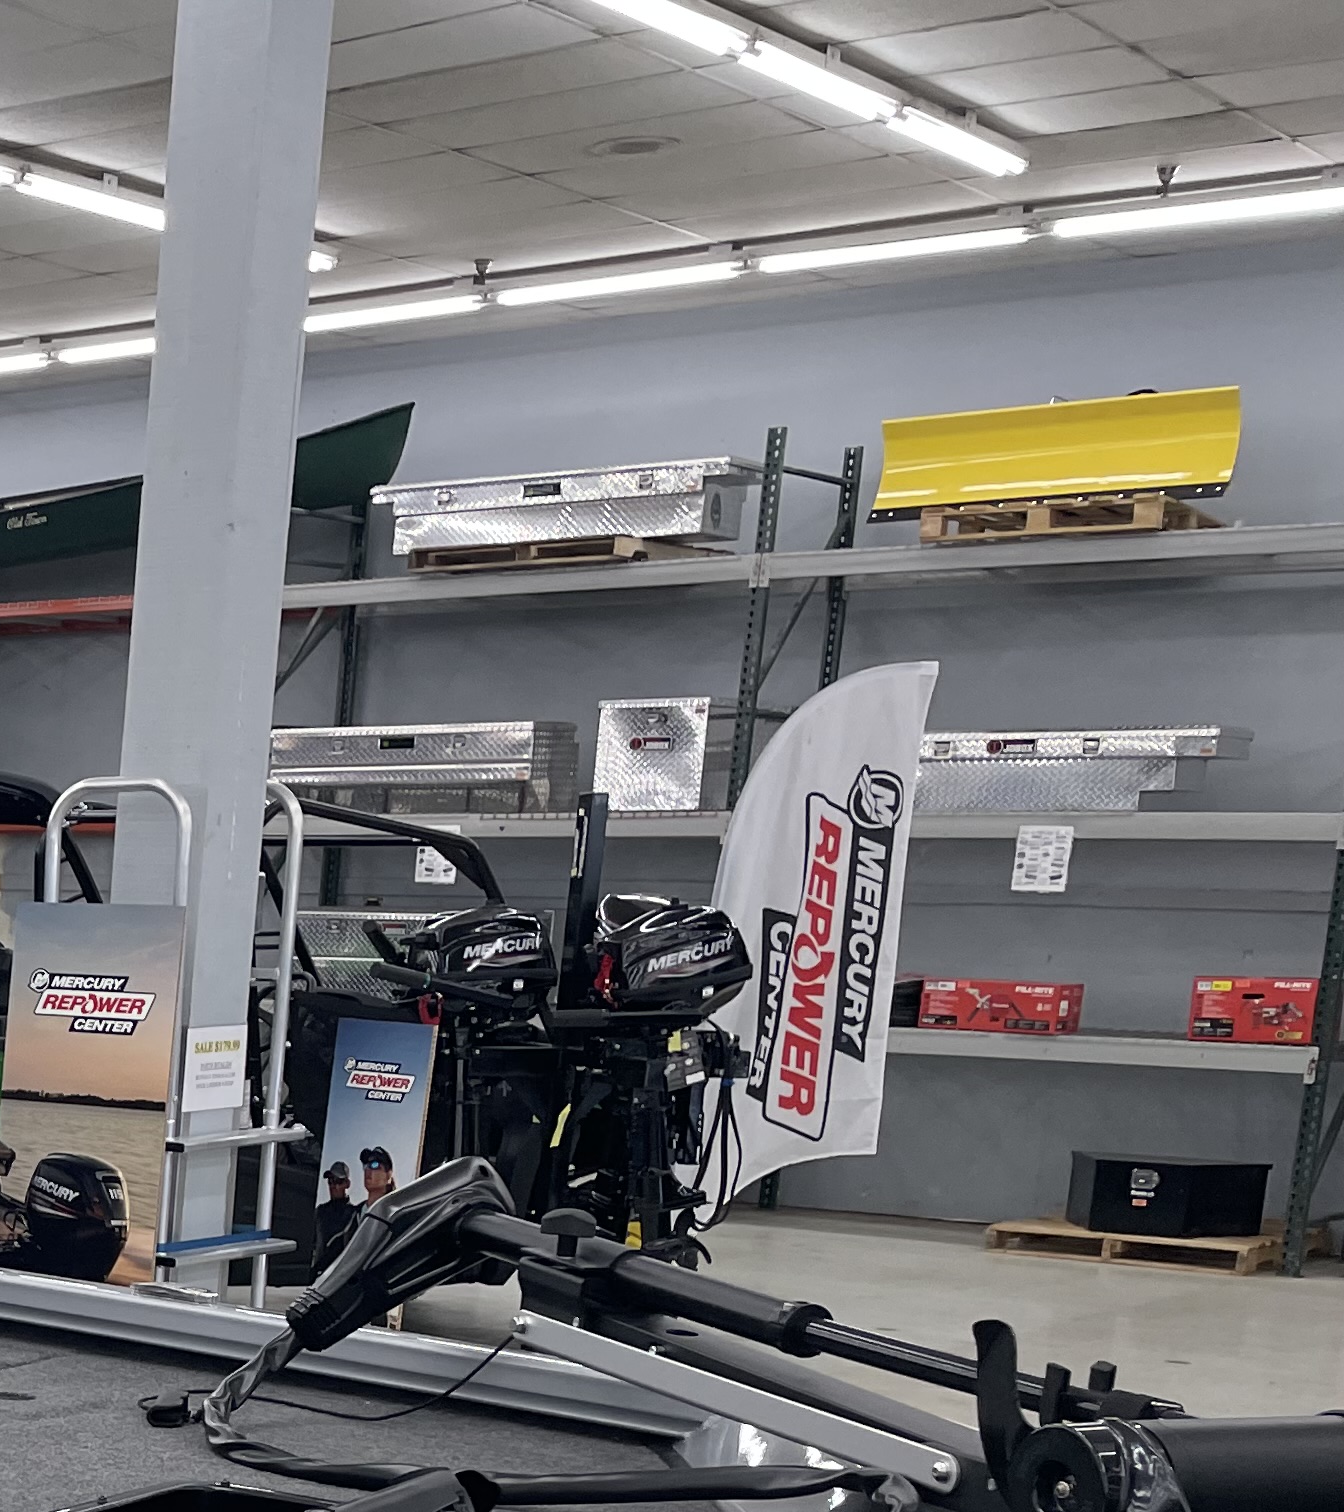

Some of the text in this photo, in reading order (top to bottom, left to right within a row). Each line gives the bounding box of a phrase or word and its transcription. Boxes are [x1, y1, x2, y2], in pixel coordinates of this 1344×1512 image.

[463, 937, 543, 960] MERCURY
[648, 936, 734, 973] MERCURY
[840, 835, 886, 1054] MERCURY
[778, 815, 844, 1117] REPOWER
[50, 976, 126, 990] MERCURY
[42, 993, 146, 1015] REPOWER
[749, 920, 793, 1089] CENTER
[73, 1018, 134, 1034] CENTER
[356, 1061, 399, 1072] MERCURY
[350, 1073, 410, 1089] REPOWER
[368, 1090, 403, 1102] CENTER
